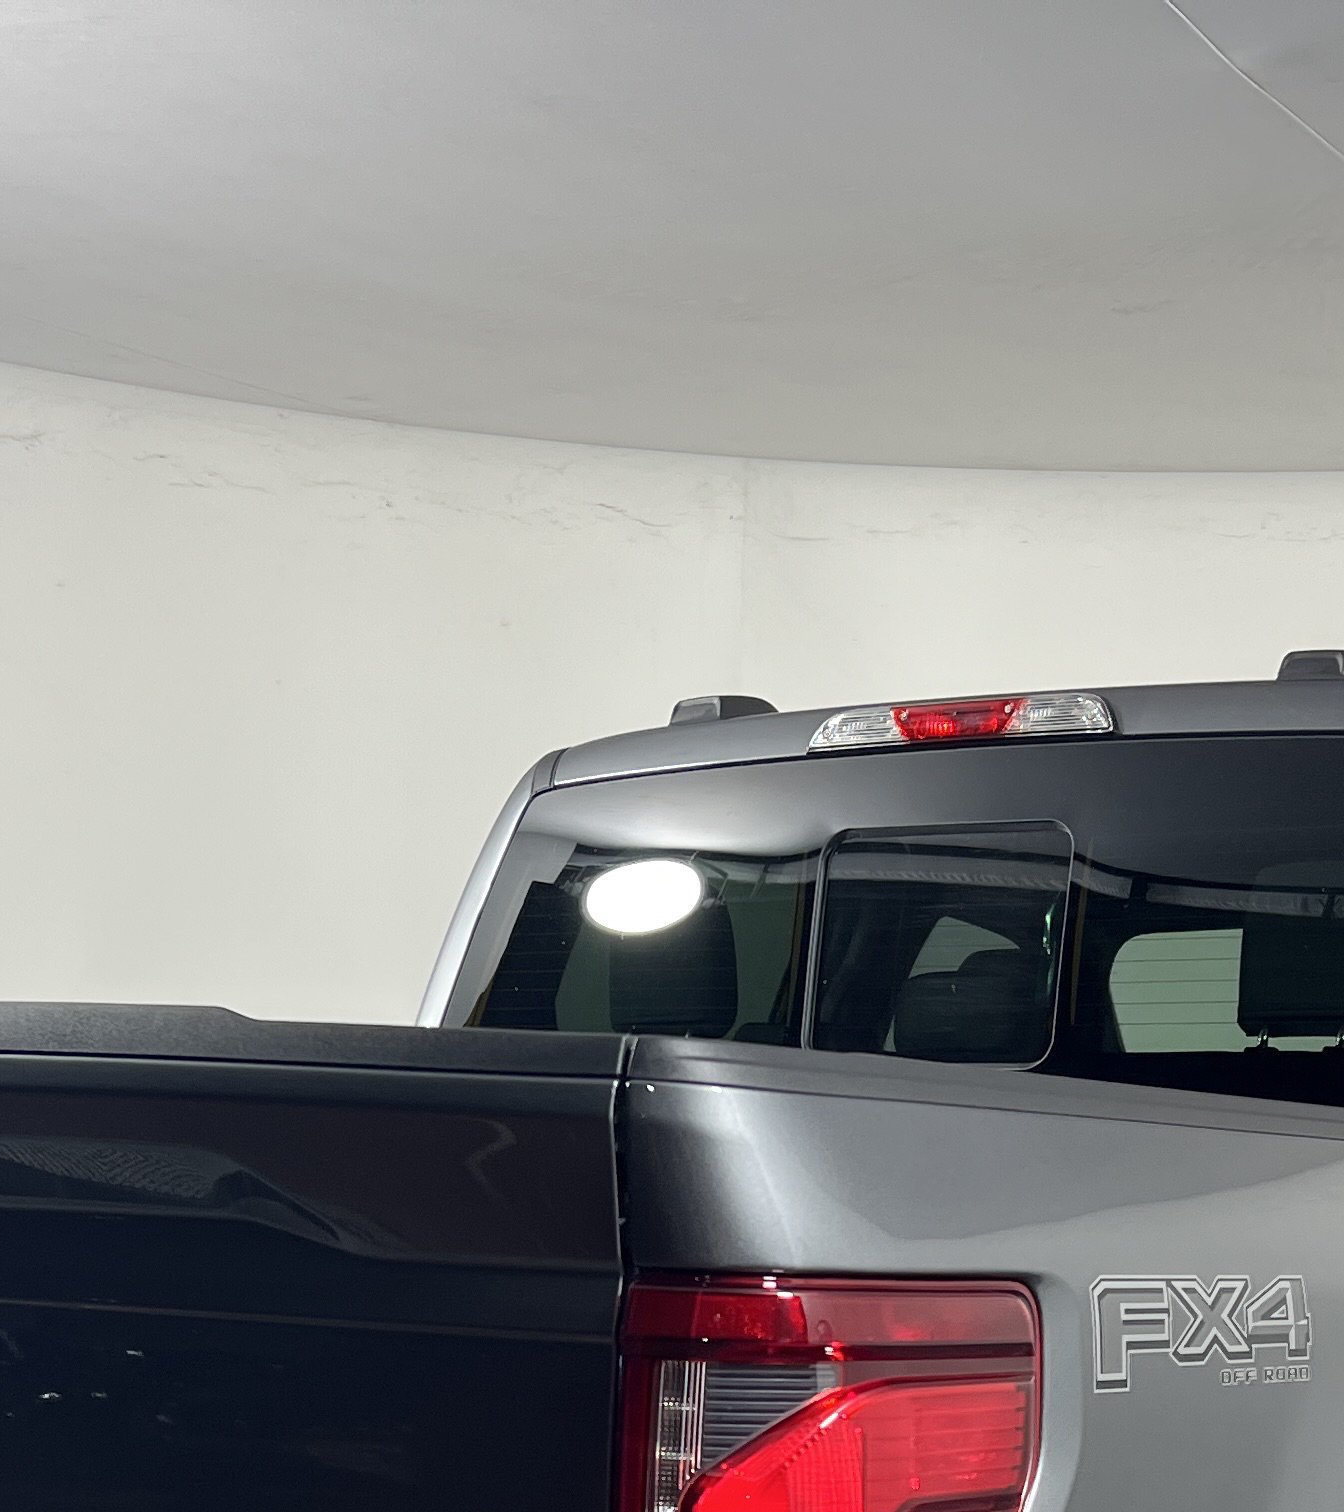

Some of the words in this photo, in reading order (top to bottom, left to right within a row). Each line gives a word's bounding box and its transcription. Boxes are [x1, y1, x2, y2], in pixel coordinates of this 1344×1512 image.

[1089, 1275, 1312, 1393] FX4
[1219, 1367, 1257, 1386] OFF
[1263, 1364, 1312, 1383] ROAD
